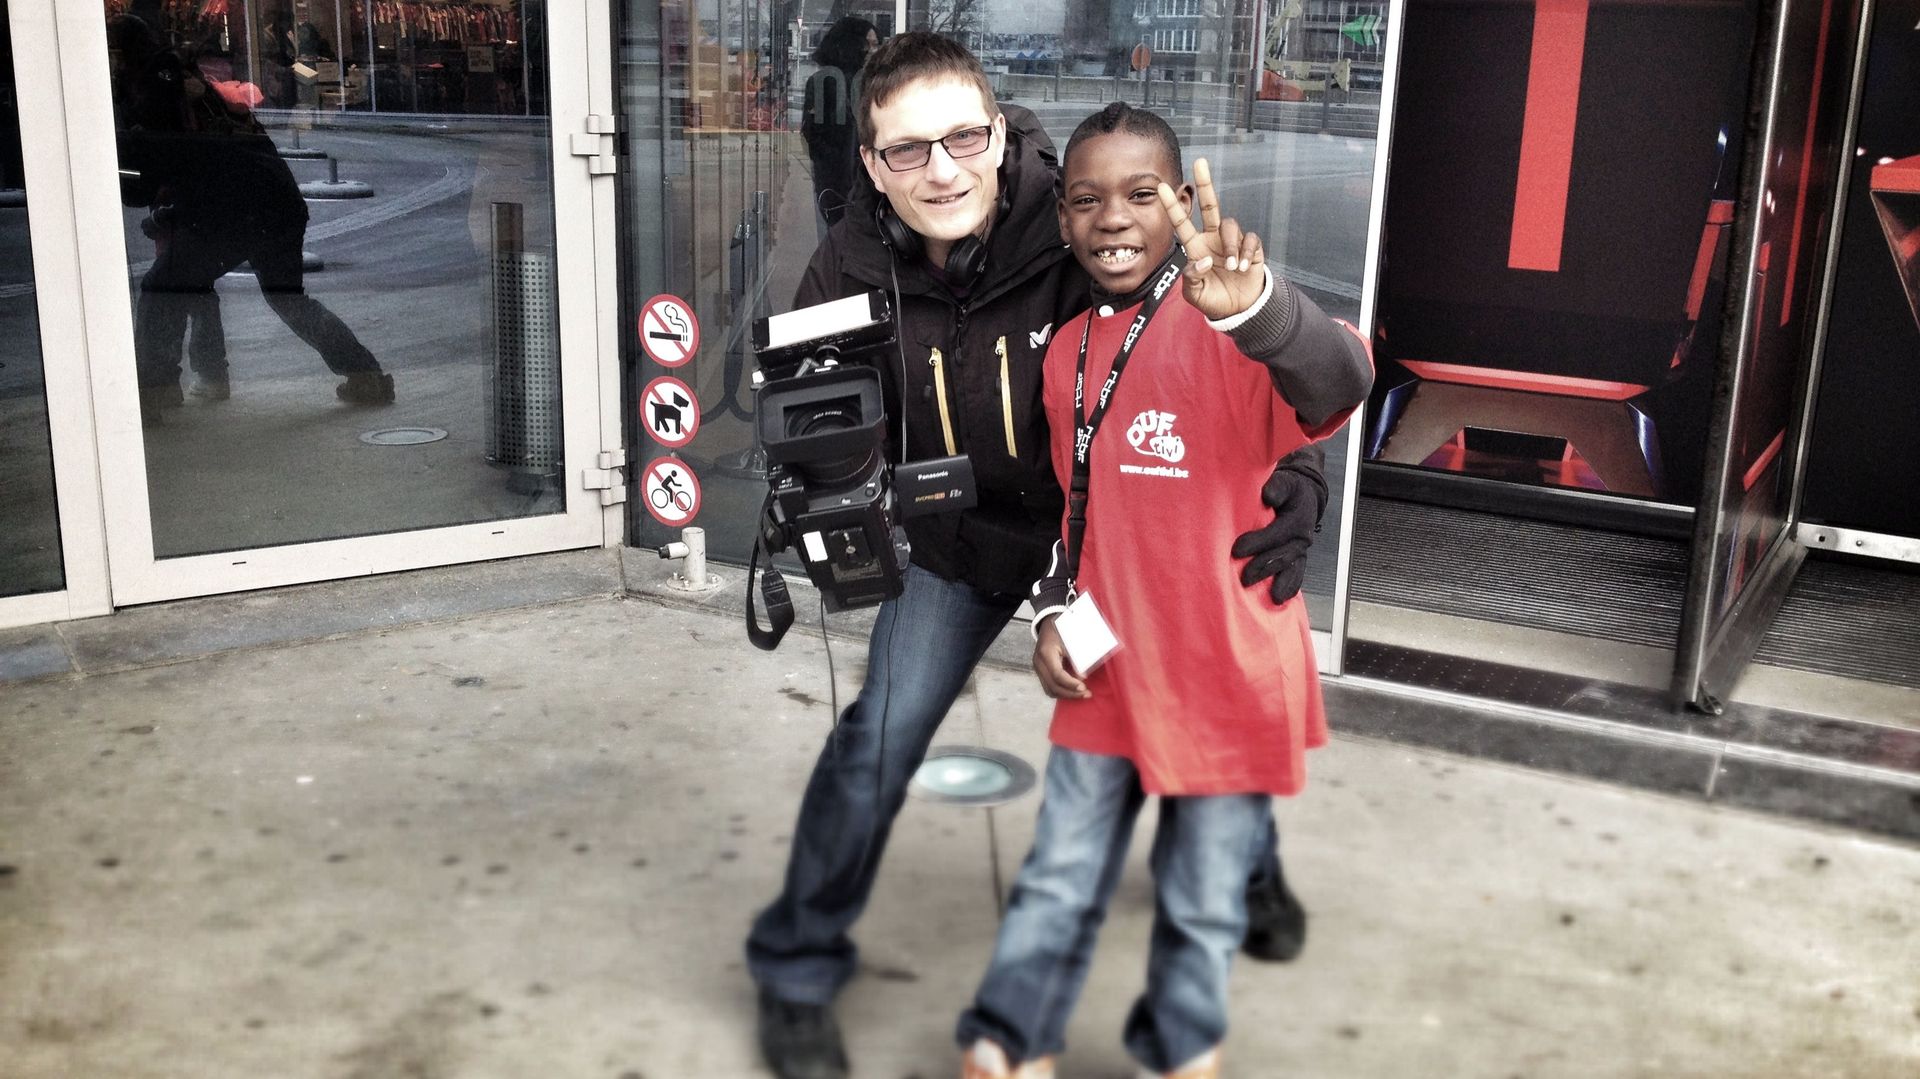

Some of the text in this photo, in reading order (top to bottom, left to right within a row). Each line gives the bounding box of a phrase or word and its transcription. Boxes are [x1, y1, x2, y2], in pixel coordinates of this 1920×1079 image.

[1126, 409, 1177, 448] OUF
[1153, 438, 1180, 457] tivi
[917, 470, 949, 481] Panasonic
